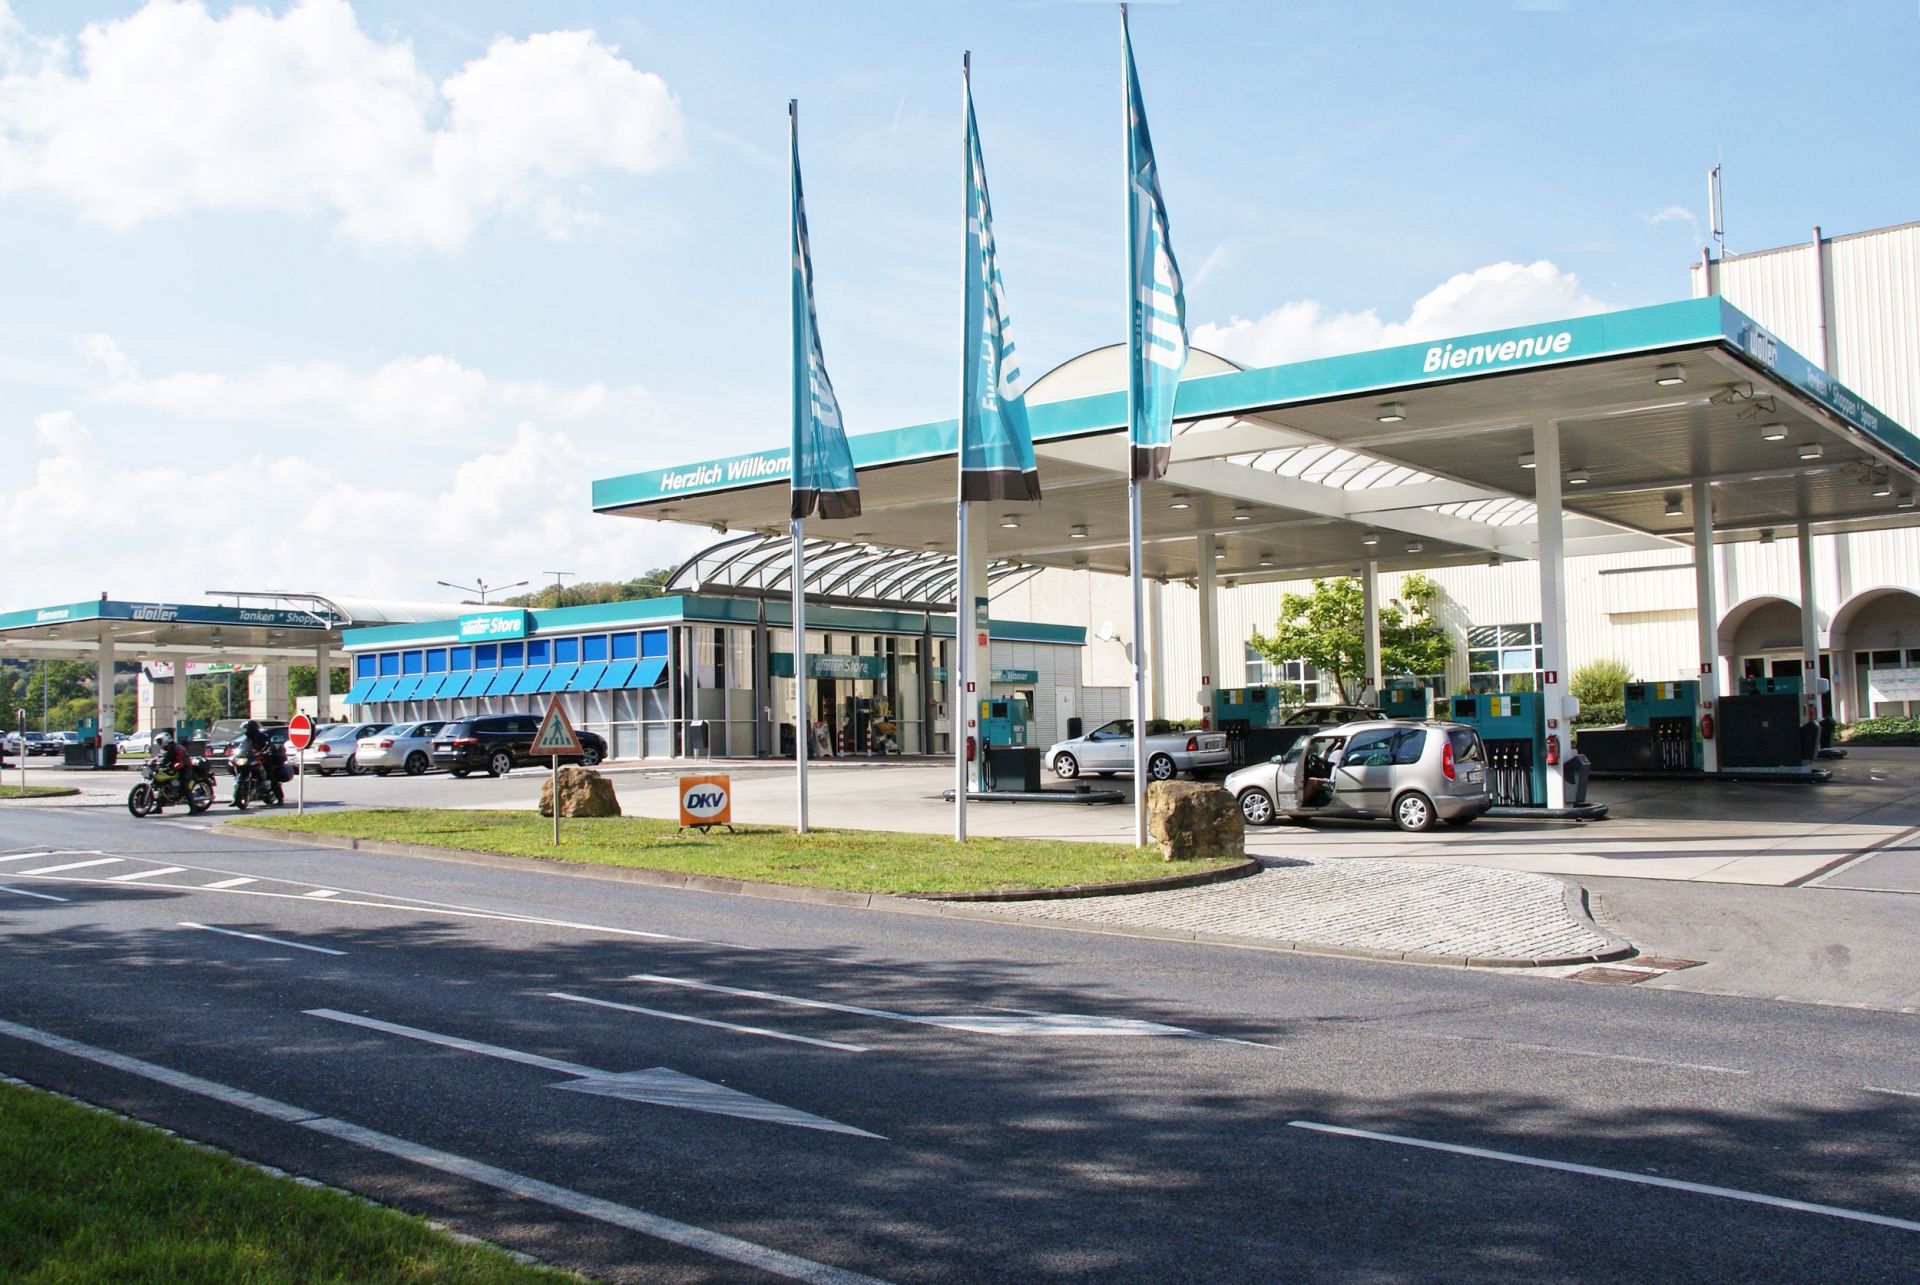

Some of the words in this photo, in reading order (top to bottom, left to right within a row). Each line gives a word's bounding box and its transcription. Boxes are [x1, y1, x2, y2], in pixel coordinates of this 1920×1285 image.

[1423, 332, 1572, 373] Bienvenue
[1807, 367, 1827, 398] Tanken
[1833, 386, 1856, 417] Shoppen
[660, 463, 723, 492] Herzlich
[727, 455, 792, 482] Willkom
[239, 610, 275, 622] Tanken
[490, 617, 521, 634] Store
[844, 659, 869, 673] Store
[687, 792, 724, 809] DKV
